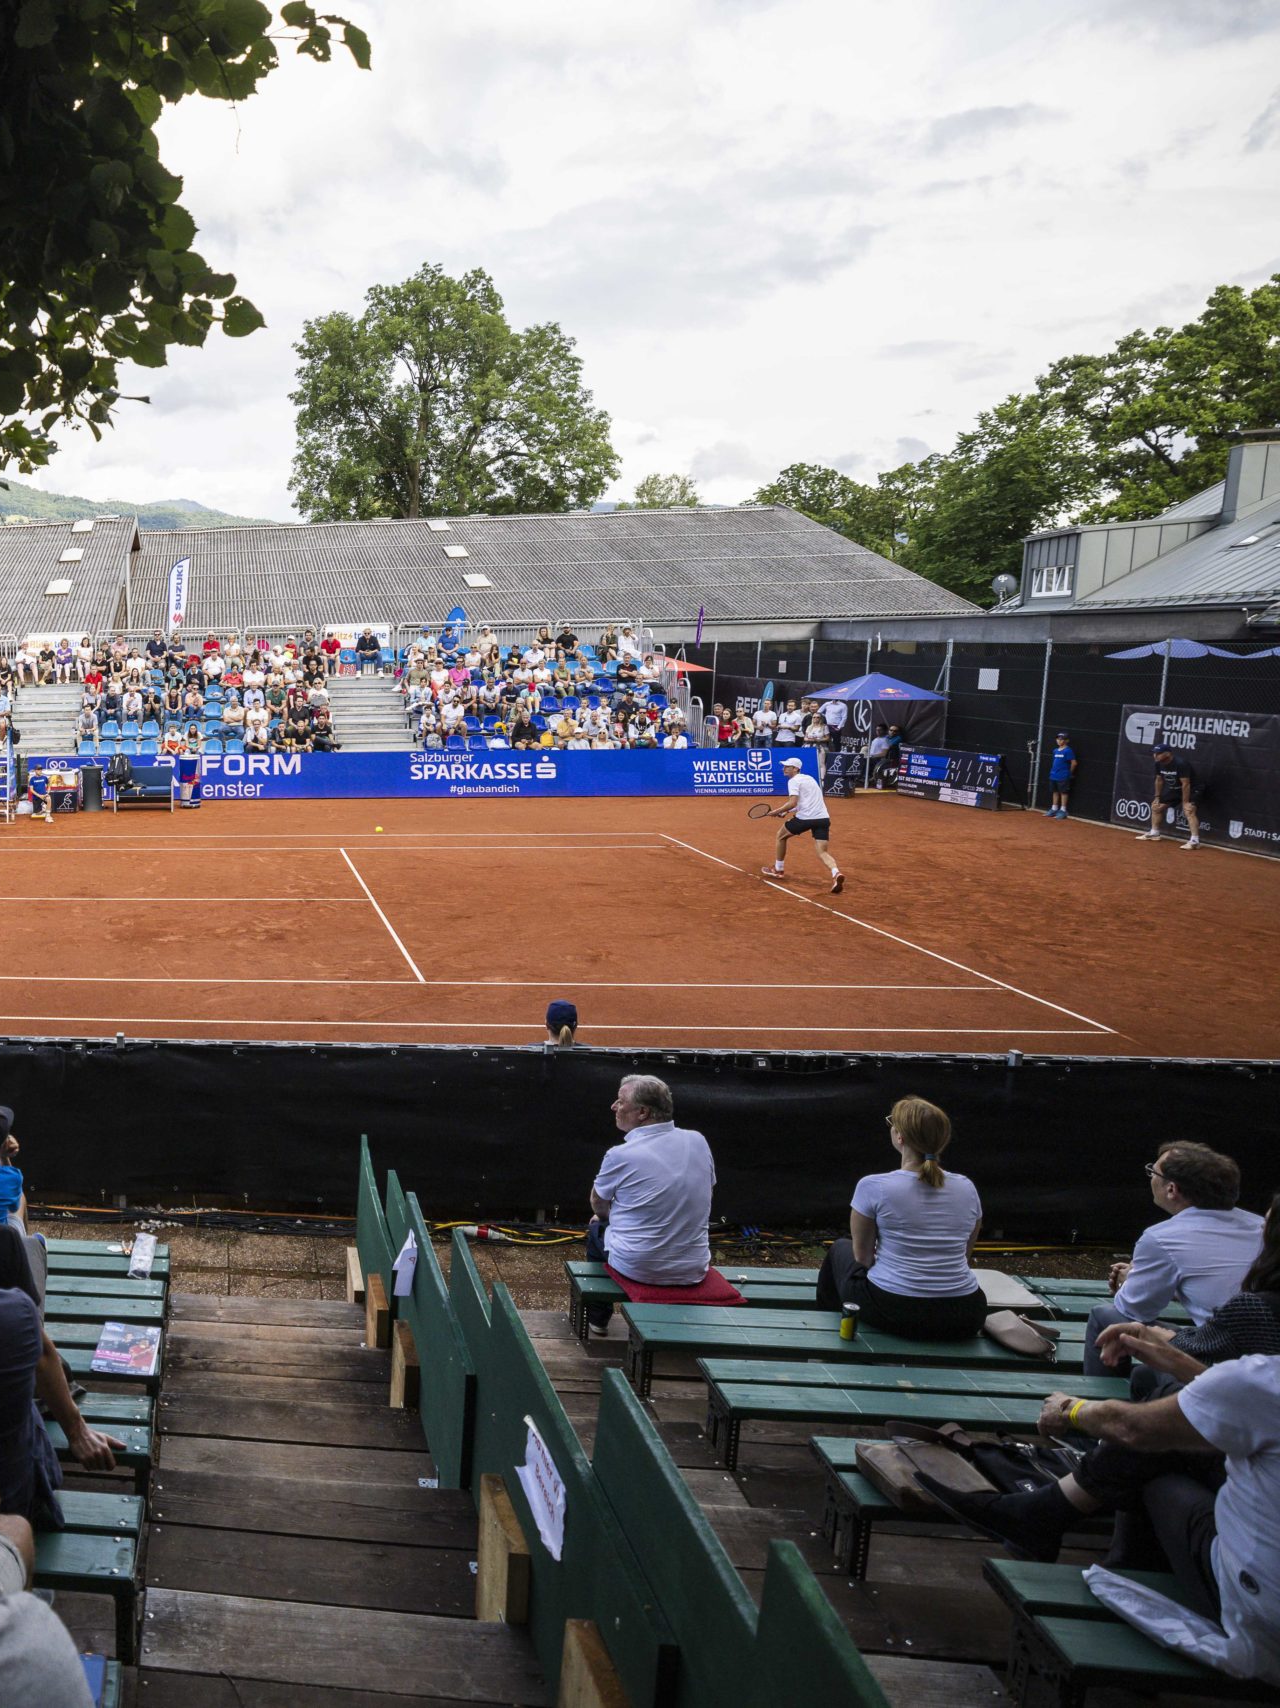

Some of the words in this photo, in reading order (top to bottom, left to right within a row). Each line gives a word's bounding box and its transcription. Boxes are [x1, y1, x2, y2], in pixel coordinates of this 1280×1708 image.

[175, 564, 184, 610] SUZUKI
[1163, 714, 1251, 738] CHALLENGER
[1162, 731, 1197, 750] TOUR
[410, 752, 474, 765] Salzburger
[692, 760, 746, 771] WIENER
[951, 761, 956, 769] 2
[985, 765, 993, 773] 15
[410, 763, 533, 780] SPARKASSE
[693, 770, 773, 783] STÄDTISCHE
[910, 769, 929, 777] OFNER
[905, 776, 922, 784] RETURN
[986, 777, 992, 785] 0
[202, 780, 264, 797] enster
[449, 784, 520, 795] #glaubandich
